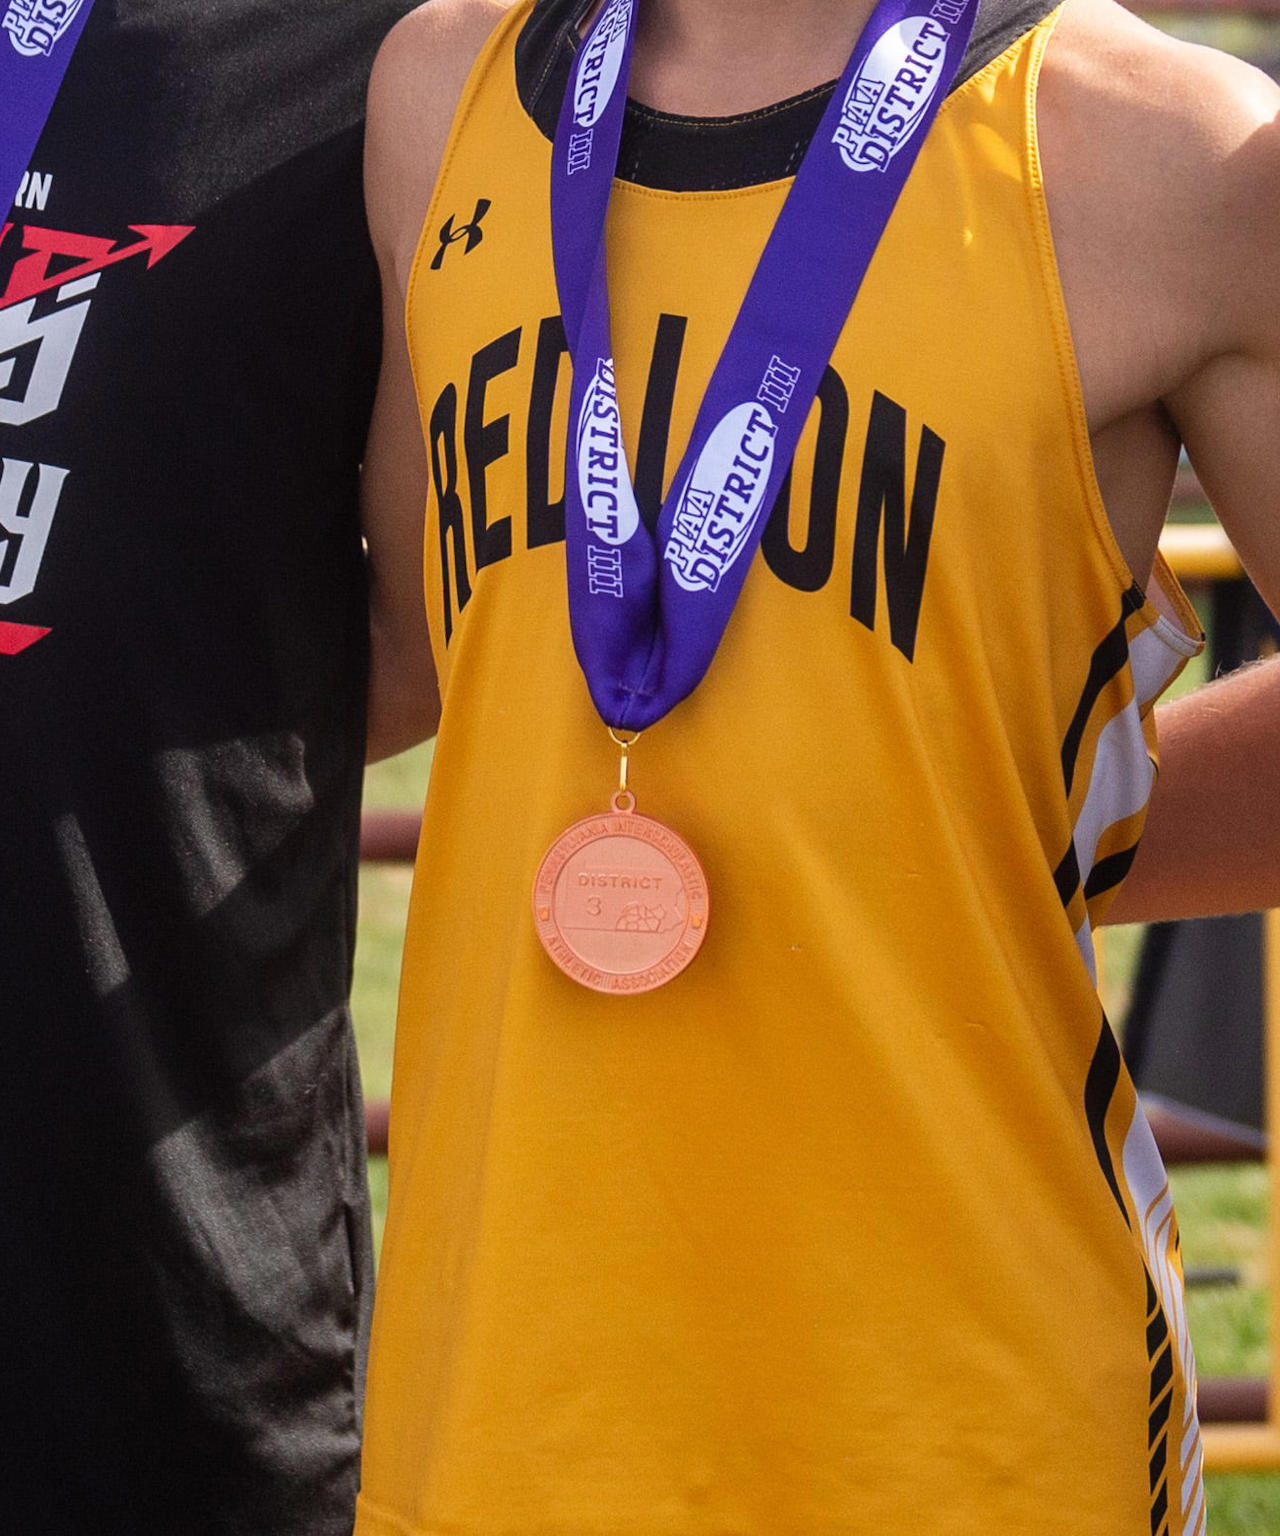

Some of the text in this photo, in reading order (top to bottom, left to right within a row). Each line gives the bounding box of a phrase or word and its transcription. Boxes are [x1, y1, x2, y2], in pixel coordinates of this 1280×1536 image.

[831, 77, 886, 155] PIAA
[860, 22, 951, 173] DISTRICT
[567, 128, 594, 176] III
[429, 313, 946, 664] RED LON
[690, 355, 801, 592] DISTRICT III
[664, 487, 715, 573] PIAA
[588, 545, 624, 598] III
[577, 872, 663, 890] DISTRICT
[586, 896, 602, 917] 3
